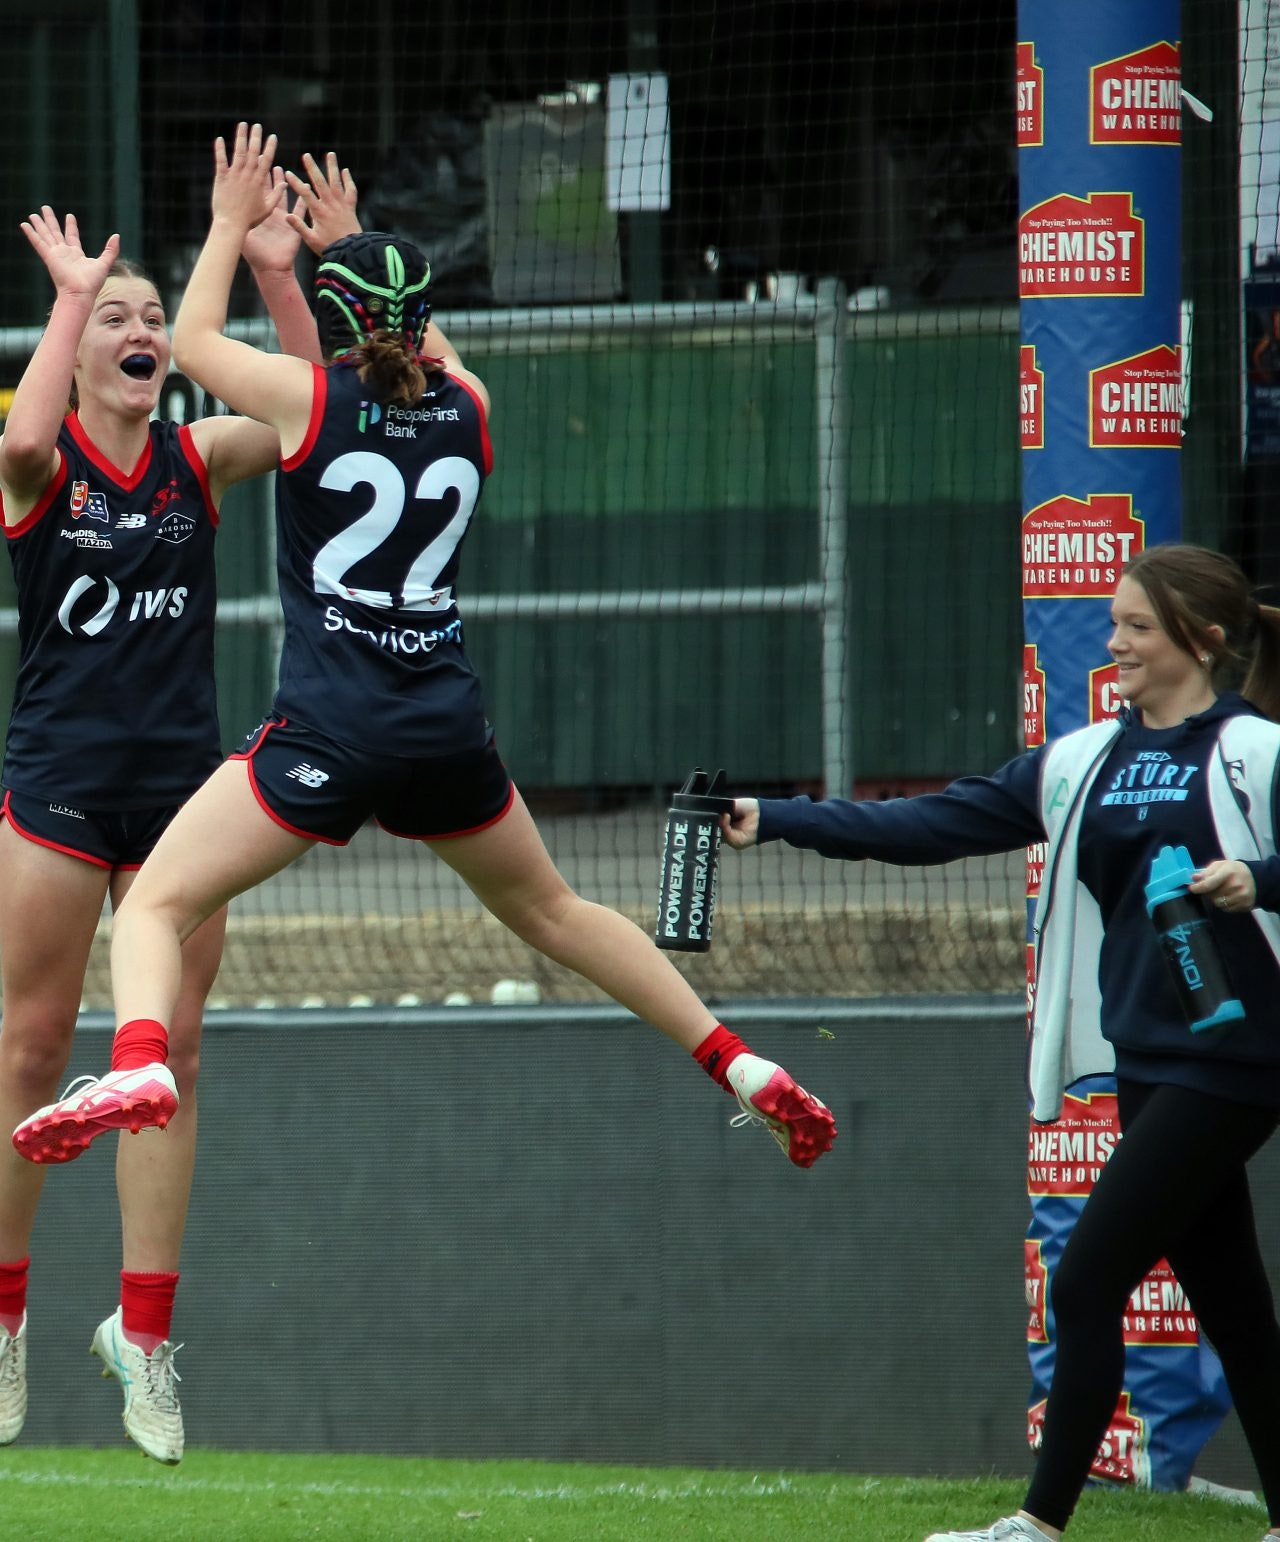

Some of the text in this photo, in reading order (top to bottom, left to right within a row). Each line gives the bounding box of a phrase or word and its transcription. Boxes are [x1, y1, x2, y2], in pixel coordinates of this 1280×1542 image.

[1125, 65, 1142, 74] Stop
[1102, 78, 1182, 110] CHEMI
[1102, 114, 1182, 130] WAREHOU
[1029, 218, 1113, 228] Stop Paying Too Much!!
[1021, 231, 1135, 263] CHEMIST
[1124, 369, 1142, 379] Stop
[1144, 369, 1165, 378] Paying
[1101, 382, 1182, 413] CHEMIS
[387, 405, 460, 423] PeopleFirst
[385, 421, 417, 439] Bank
[1102, 418, 1181, 433] WAREHOU
[312, 451, 480, 612] 22
[1030, 519, 1112, 530] Stop Paying Too Much!!
[60, 529, 98, 539] PARADISE
[78, 538, 112, 548] MAZDA
[1024, 532, 1135, 564] CHEMIST
[1024, 568, 1115, 584] WAREHOUS
[129, 586, 188, 622] IWS
[1111, 763, 1200, 791] STURT
[1113, 790, 1176, 805] FOOTBALL
[665, 822, 688, 938] POWERADE
[688, 824, 712, 940] POWERADE
[1168, 924, 1204, 991] ION4
[1068, 1119, 1081, 1127] Too
[1083, 1118, 1113, 1127] Much!!
[1028, 1167, 1101, 1183] WAREHOU
[1123, 1315, 1197, 1332] AREHOU
